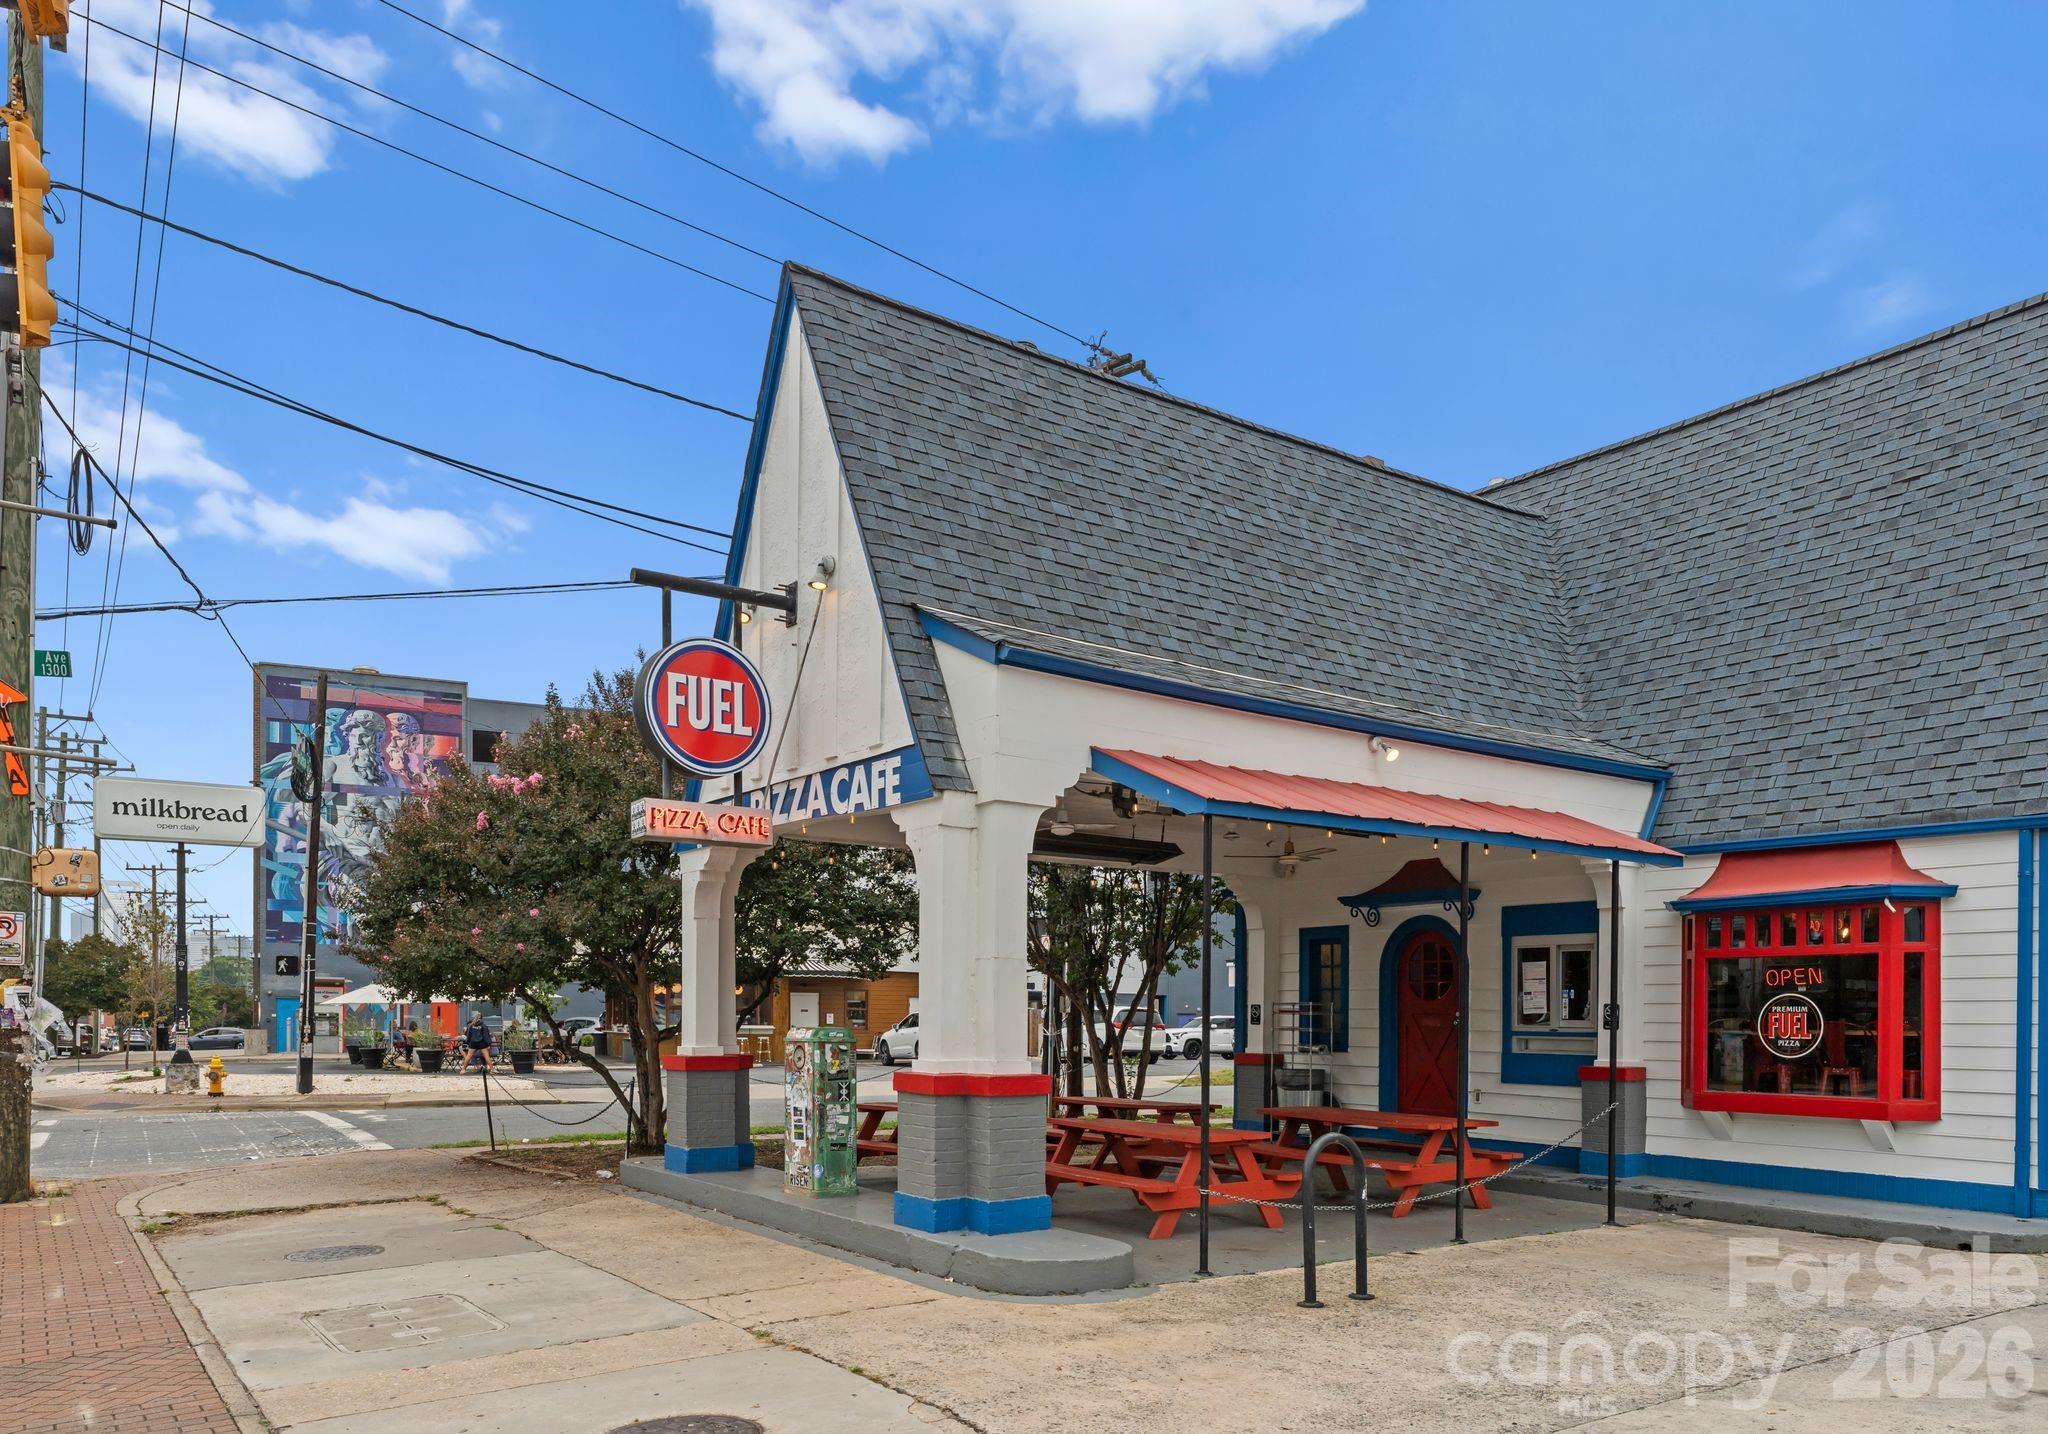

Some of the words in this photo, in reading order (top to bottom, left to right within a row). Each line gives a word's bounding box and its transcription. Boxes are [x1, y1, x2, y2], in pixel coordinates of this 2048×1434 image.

[45, 651, 67, 664] Ave
[41, 663, 67, 676] 1300
[667, 672, 753, 735] FUEL
[830, 755, 902, 815] CAFE
[112, 798, 248, 823] milkbread
[156, 822, 179, 831] open
[179, 823, 201, 833] daily
[650, 806, 710, 833] PIZZA
[717, 812, 771, 838] CAFE
[1765, 968, 1822, 986] OPEN
[1768, 1013, 1812, 1039] FUEL
[789, 1174, 808, 1187] RISEN
